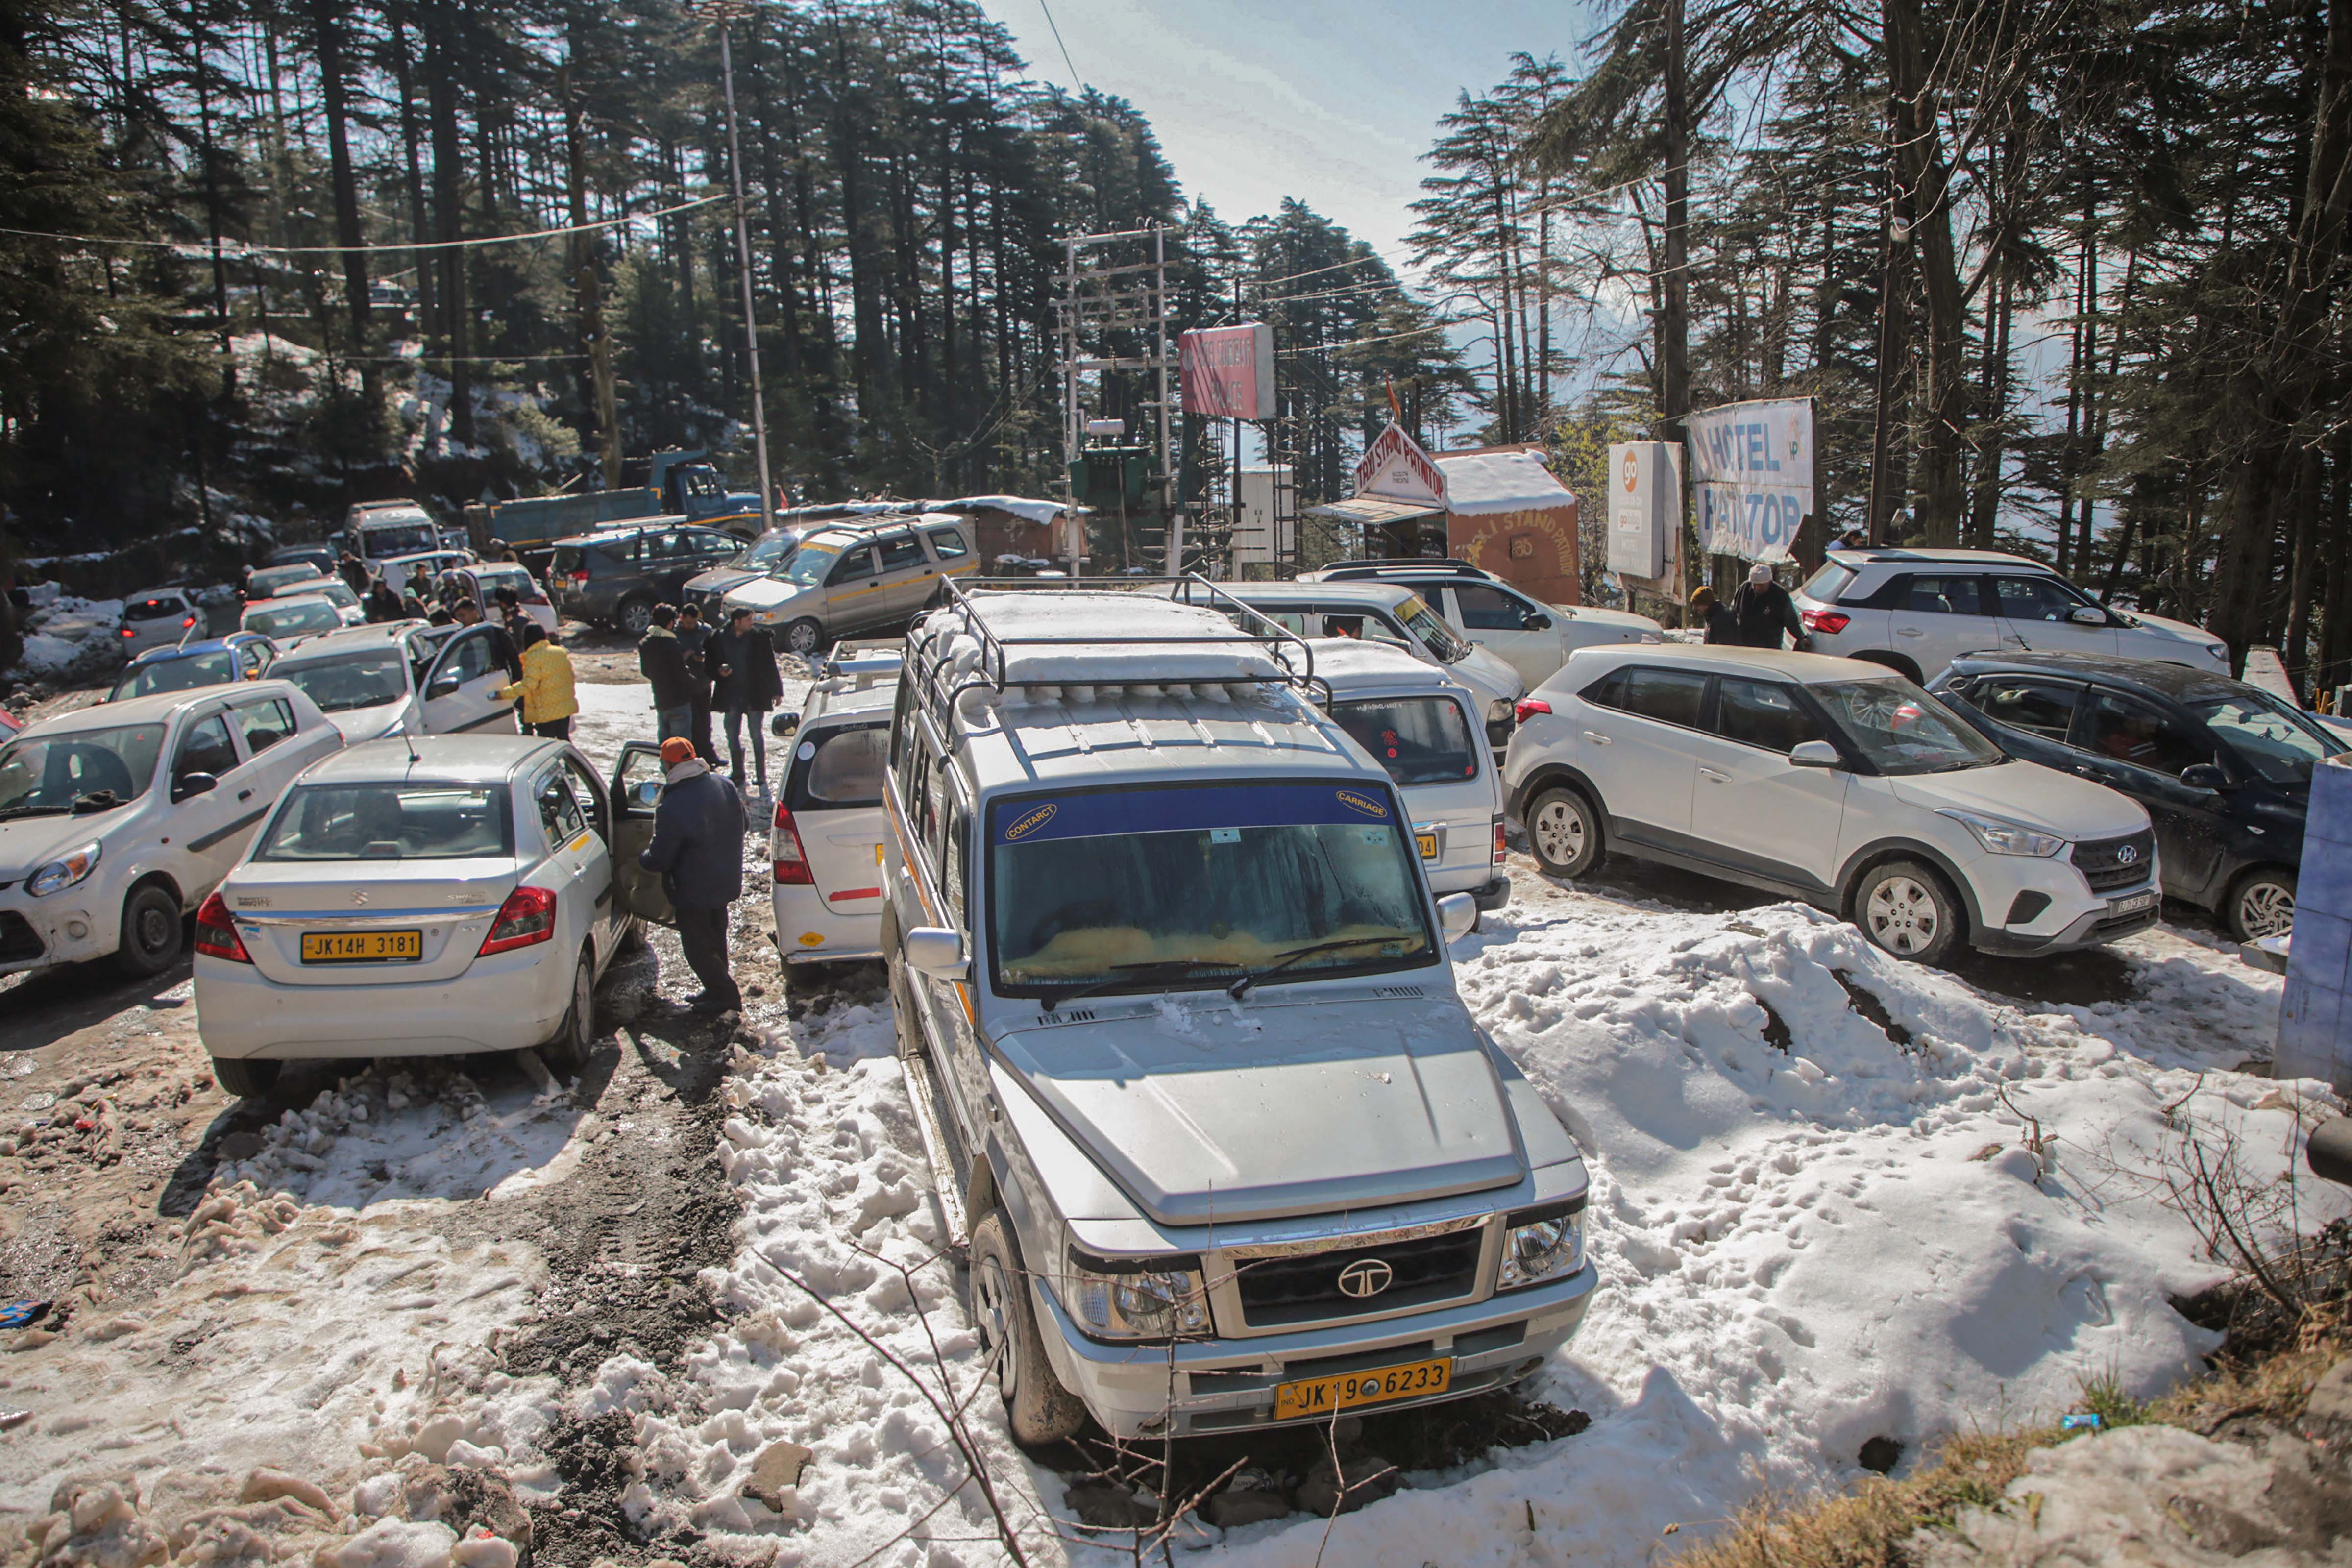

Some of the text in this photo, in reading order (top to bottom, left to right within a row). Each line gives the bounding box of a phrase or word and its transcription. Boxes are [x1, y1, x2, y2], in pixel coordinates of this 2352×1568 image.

[1707, 422, 1780, 471] HOTEL
[1357, 427, 1443, 500] TAXI STAND PATNITOP
[1624, 461, 1637, 485] go
[1503, 511, 1556, 533] STAND
[1338, 792, 1384, 816] CARRIAGE
[1008, 806, 1054, 837] CONTARCT
[377, 936, 415, 953] 3181
[1385, 1365, 1444, 1393] 6233
[1281, 1398, 1294, 1407] IND
